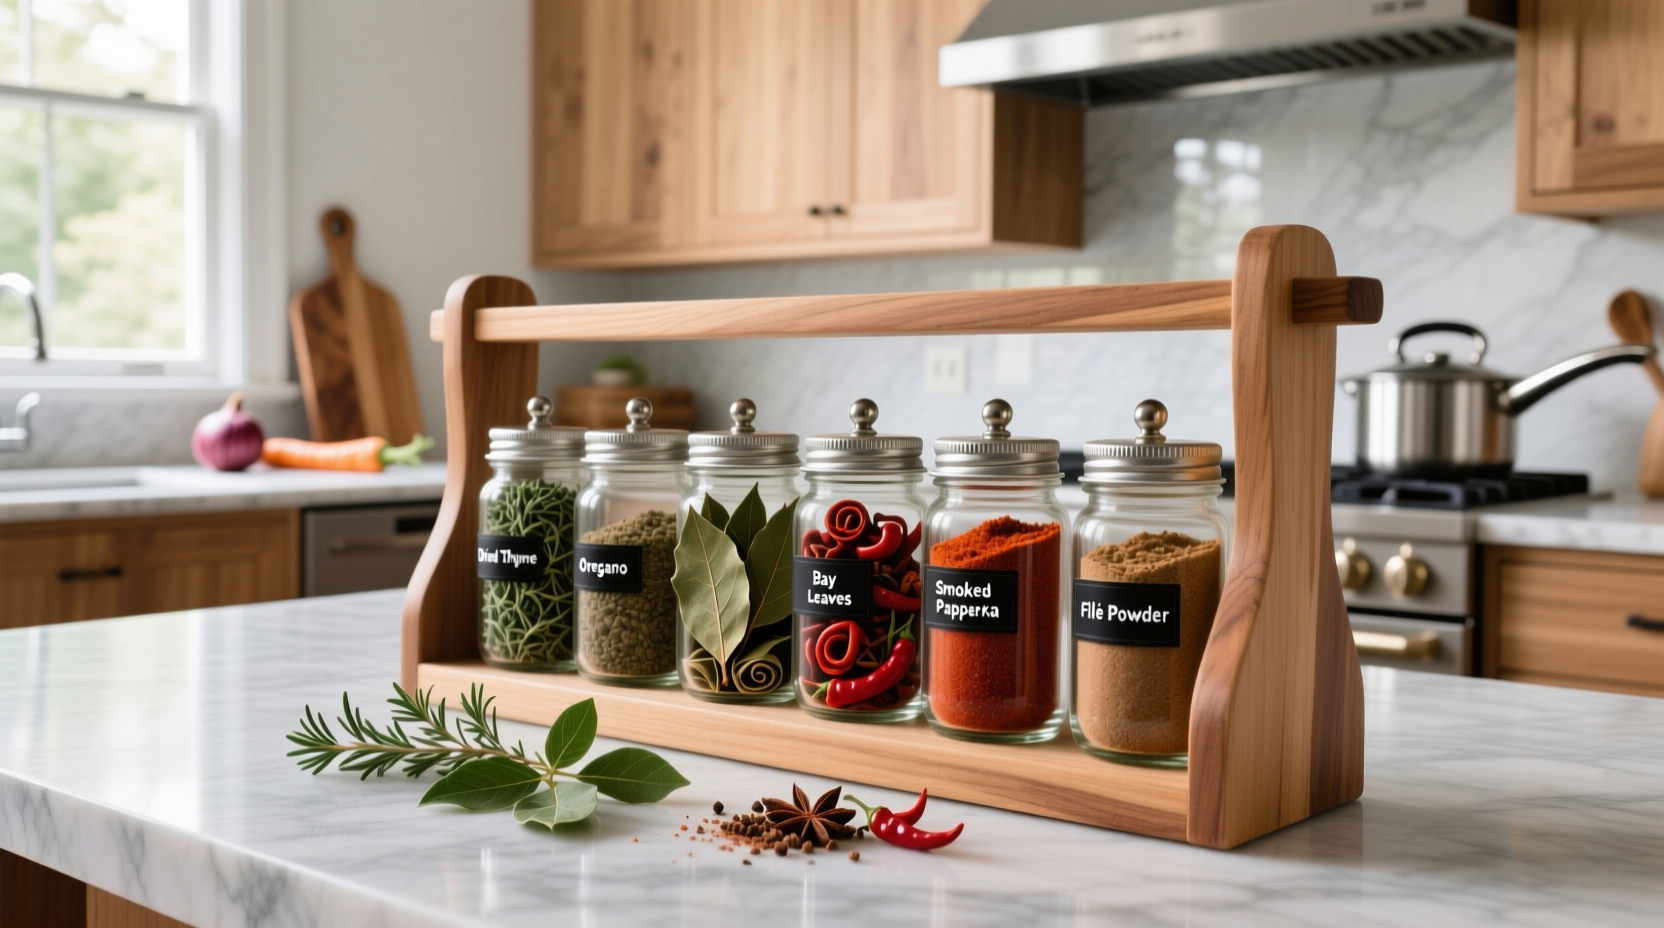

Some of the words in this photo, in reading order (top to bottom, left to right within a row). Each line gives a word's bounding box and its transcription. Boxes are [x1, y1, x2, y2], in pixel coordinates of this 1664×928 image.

[579, 557, 628, 578] Oregano
[812, 570, 837, 589] Bay
[935, 580, 992, 598] Smoked
[807, 589, 852, 606] Leaves
[1108, 604, 1170, 623] Powder
